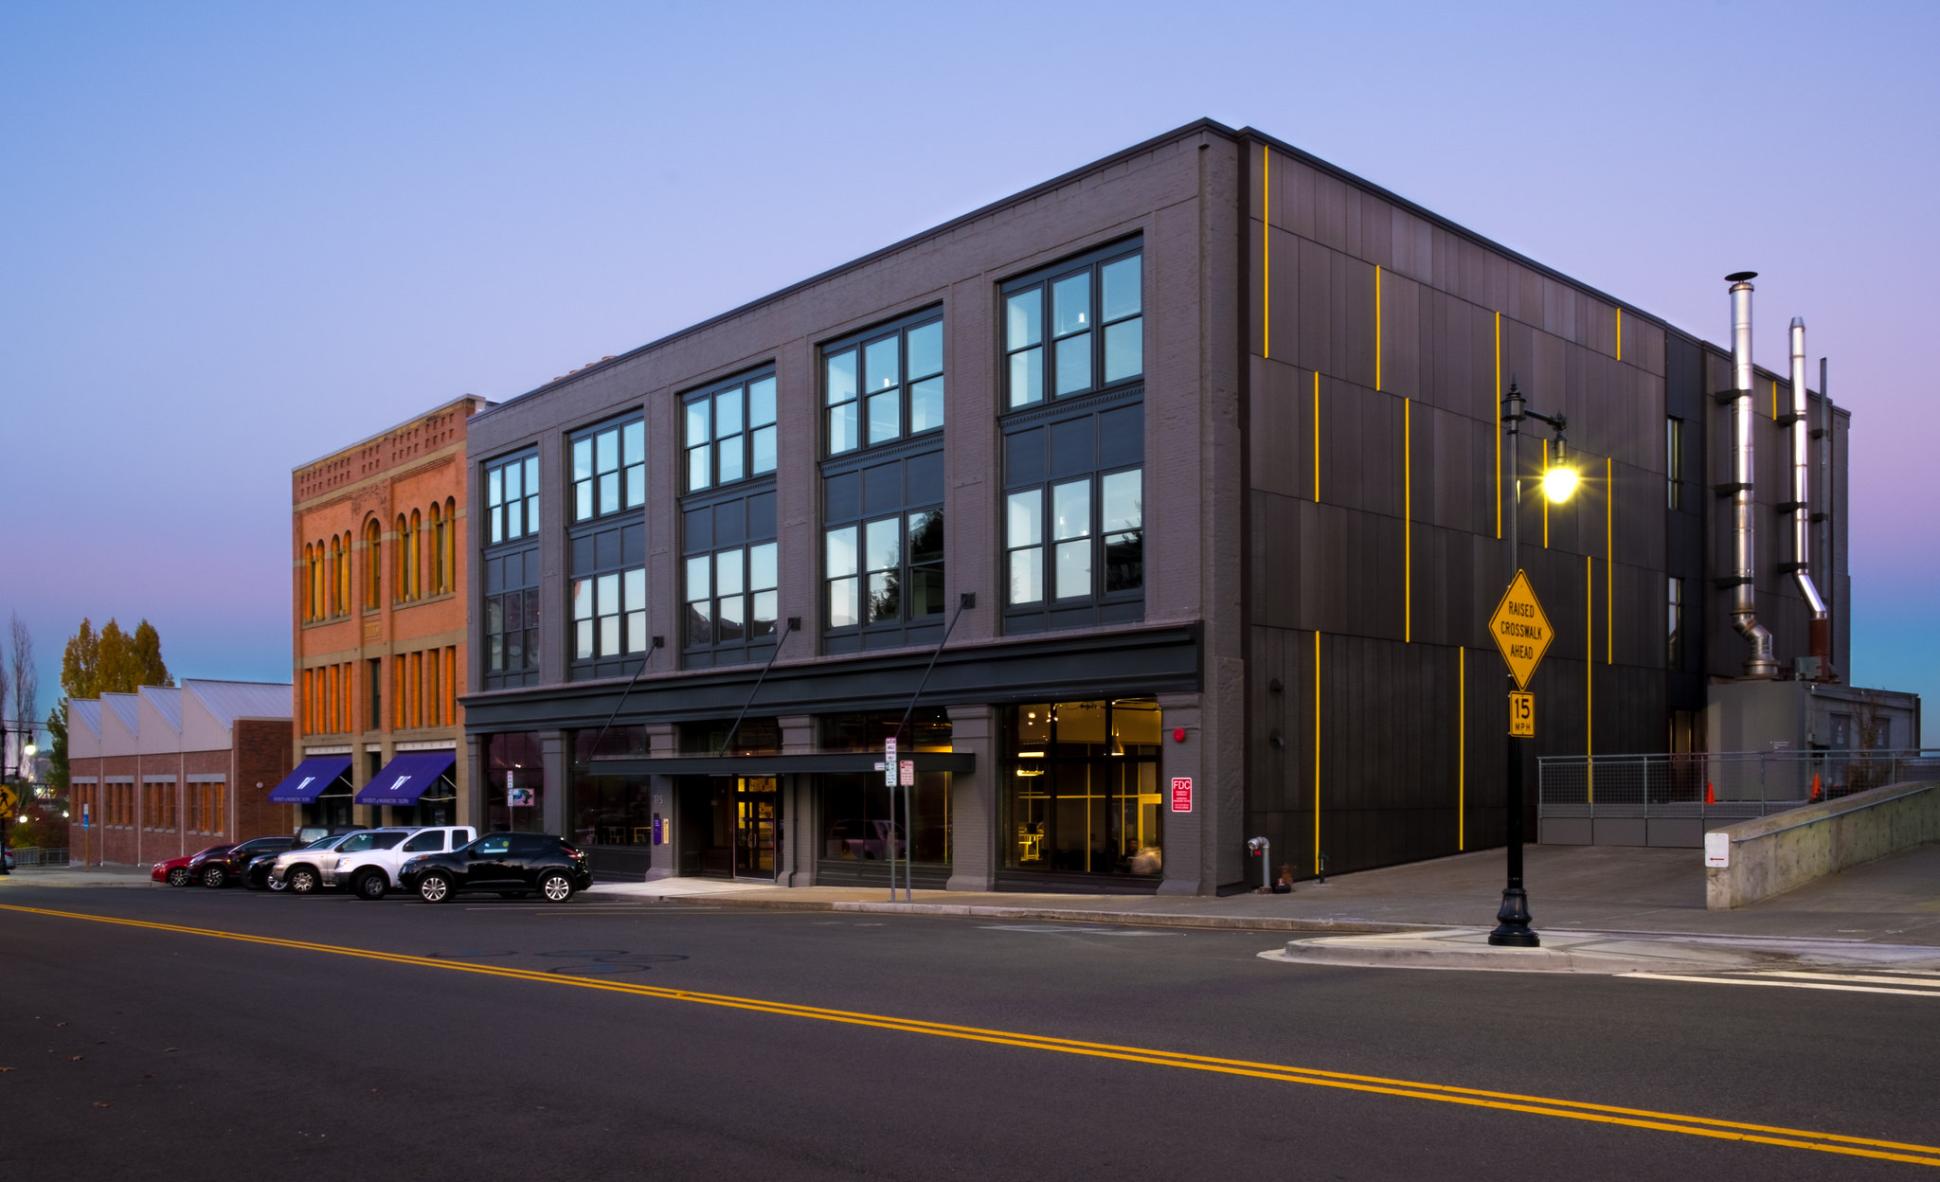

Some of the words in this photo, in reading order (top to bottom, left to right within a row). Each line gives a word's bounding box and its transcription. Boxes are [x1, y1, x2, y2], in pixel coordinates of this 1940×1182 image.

[1509, 601, 1534, 619] RAISED
[1501, 621, 1542, 640] CROSSWALK
[1510, 644, 1533, 660] AHEAD
[1515, 698, 1530, 719] 15
[1515, 723, 1531, 731] MPH
[1173, 780, 1190, 790] FDC
